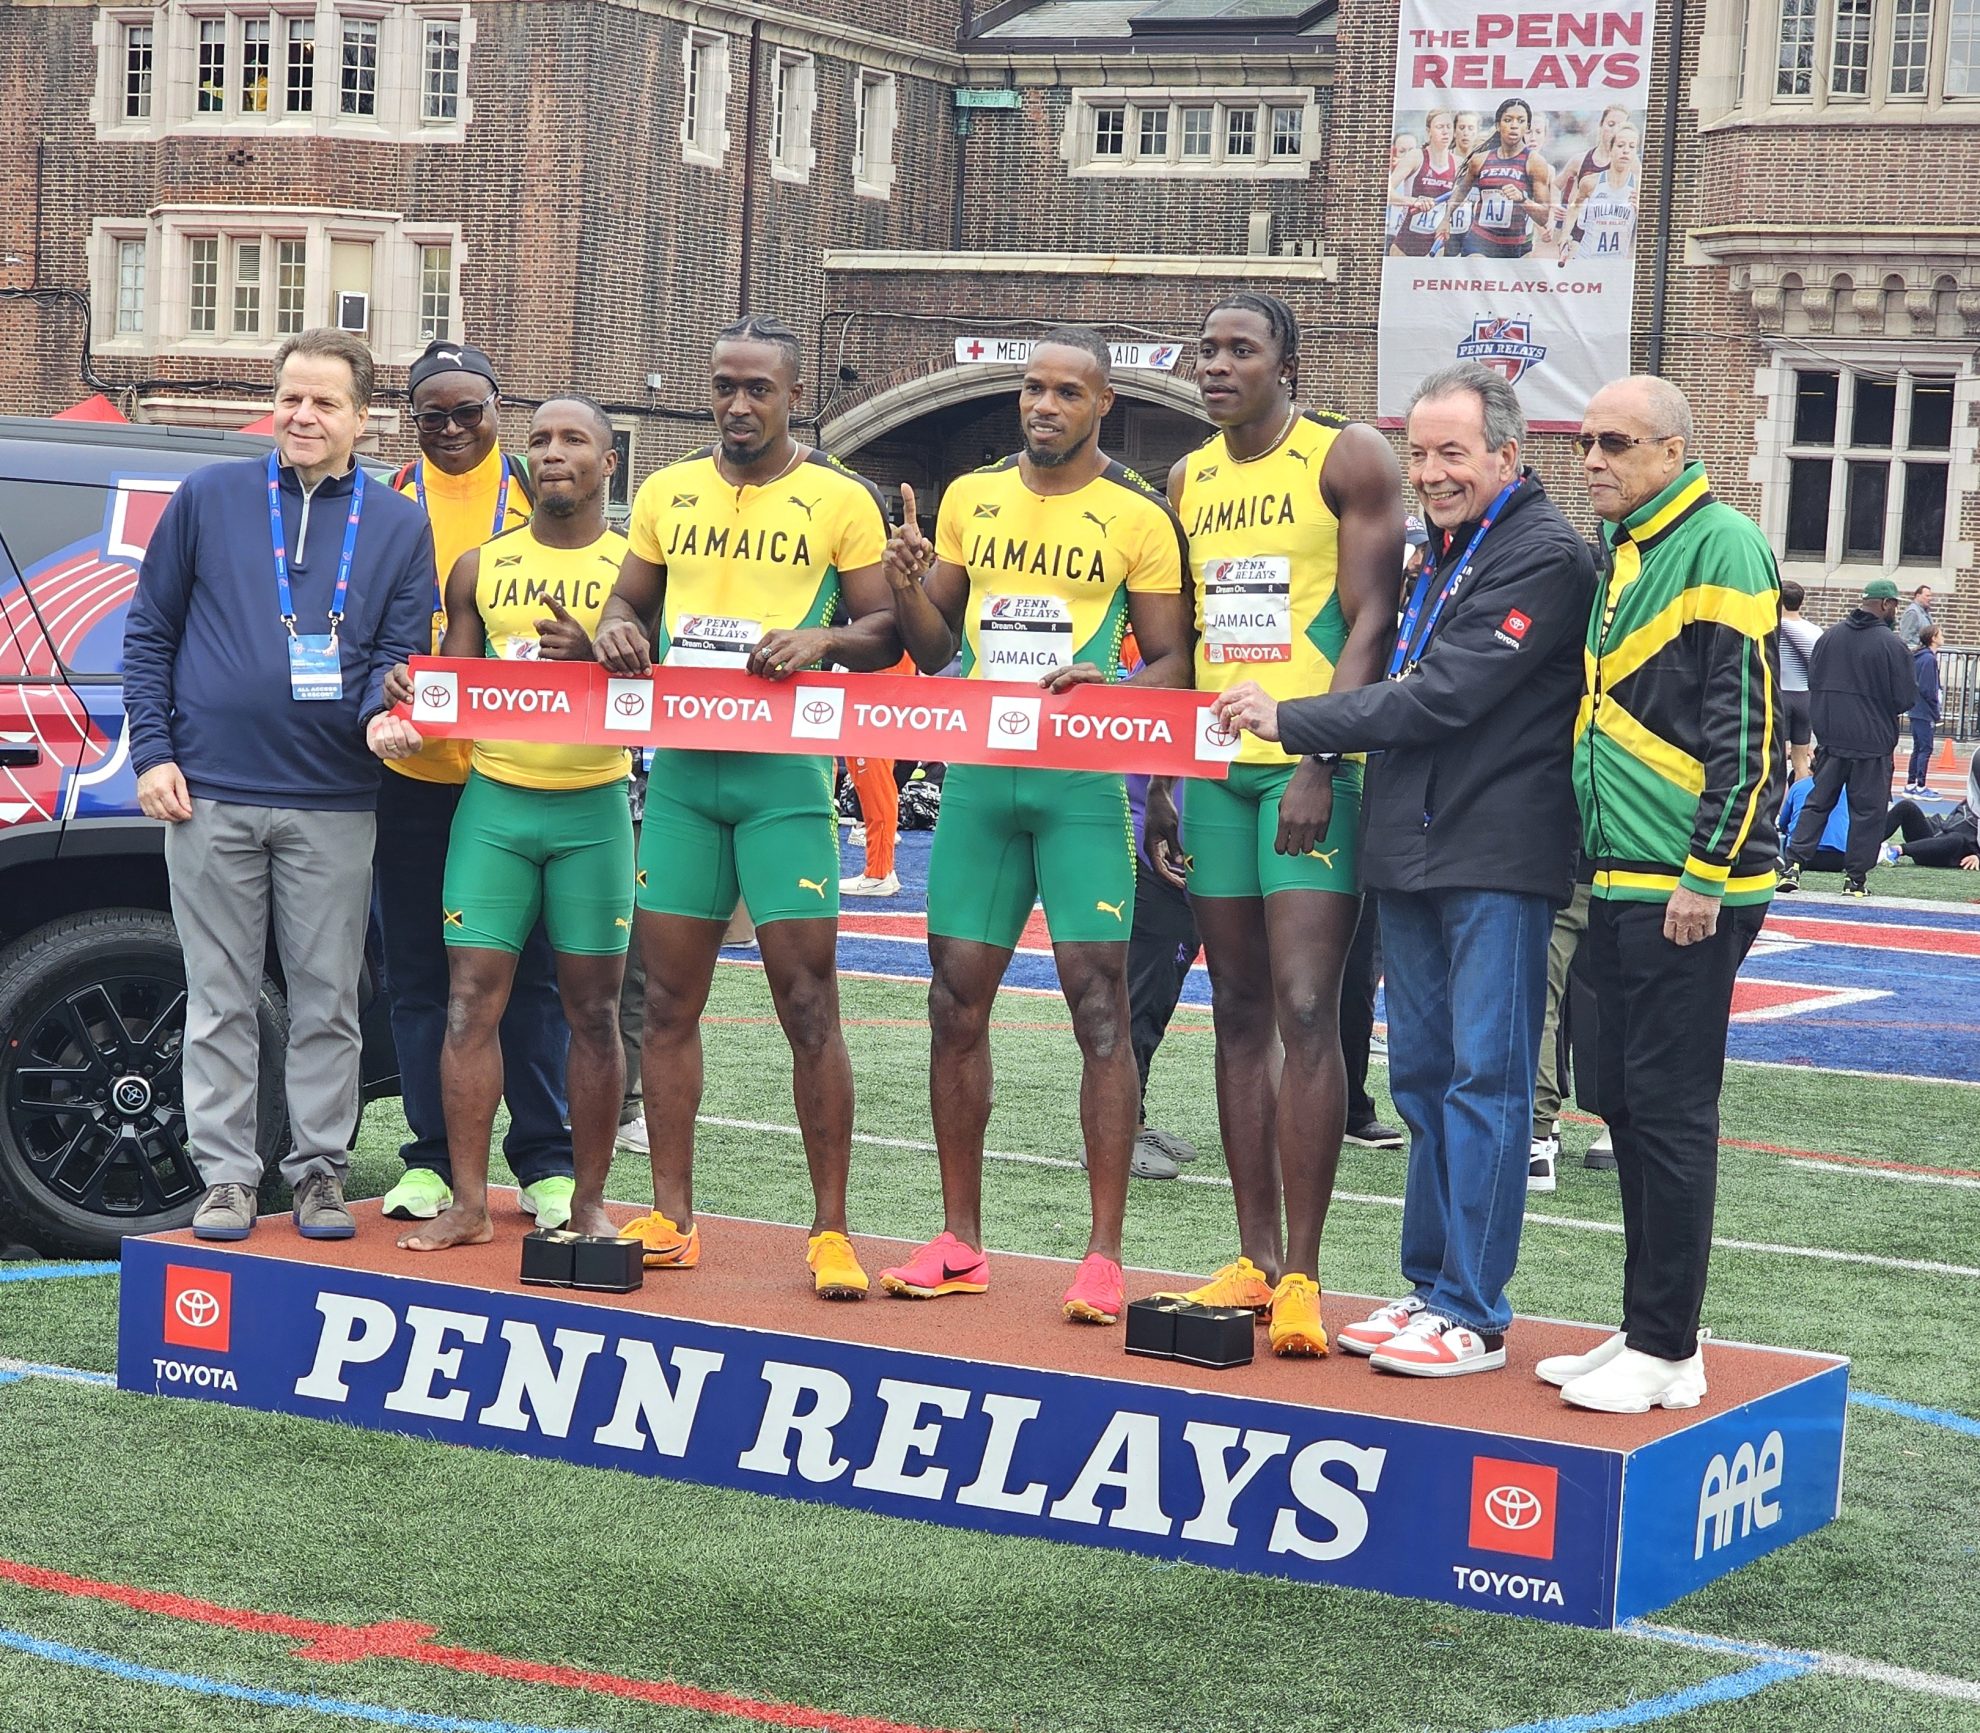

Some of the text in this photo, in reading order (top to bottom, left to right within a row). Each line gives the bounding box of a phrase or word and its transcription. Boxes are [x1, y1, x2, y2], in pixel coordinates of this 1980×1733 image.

[1409, 12, 1643, 48] THE PENN
[1412, 53, 1641, 89] RELAYS
[1480, 167, 1525, 180] PENN
[1486, 200, 1505, 221] AJ
[1593, 203, 1631, 220] VILLANOVA
[1597, 232, 1619, 252] AA
[1412, 279, 1603, 294] PENNRELAYS.COM
[996, 342, 1139, 364] MEDI AID
[1459, 344, 1544, 358] PENN RELAYS
[1189, 492, 1295, 537] JAMAICA
[667, 524, 811, 566] JAMAICA
[968, 534, 1105, 583] JAMAICA
[1236, 561, 1266, 570] PENN
[1235, 571, 1276, 580] RELAYS
[489, 578, 602, 609] JAMAIC
[1016, 599, 1049, 608] PENN
[1014, 609, 1060, 618] RELAYS
[1212, 614, 1276, 628] JAMAICA
[706, 618, 739, 628] PENN
[991, 622, 1028, 630] Dream On.
[703, 628, 749, 639] RELAYS
[1494, 629, 1520, 650] TOYOTA
[682, 639, 716, 649] Dream On.
[989, 650, 1058, 666] JAMAICA
[1225, 647, 1282, 660] TOYOTA
[467, 687, 1172, 743] TOYOTA TOYOTA TOYOTA TOYOTA
[153, 1358, 238, 1391] TOYOTA
[294, 1291, 1387, 1561] PENN RELAYS
[1452, 1565, 1564, 1607] TOYOTA
